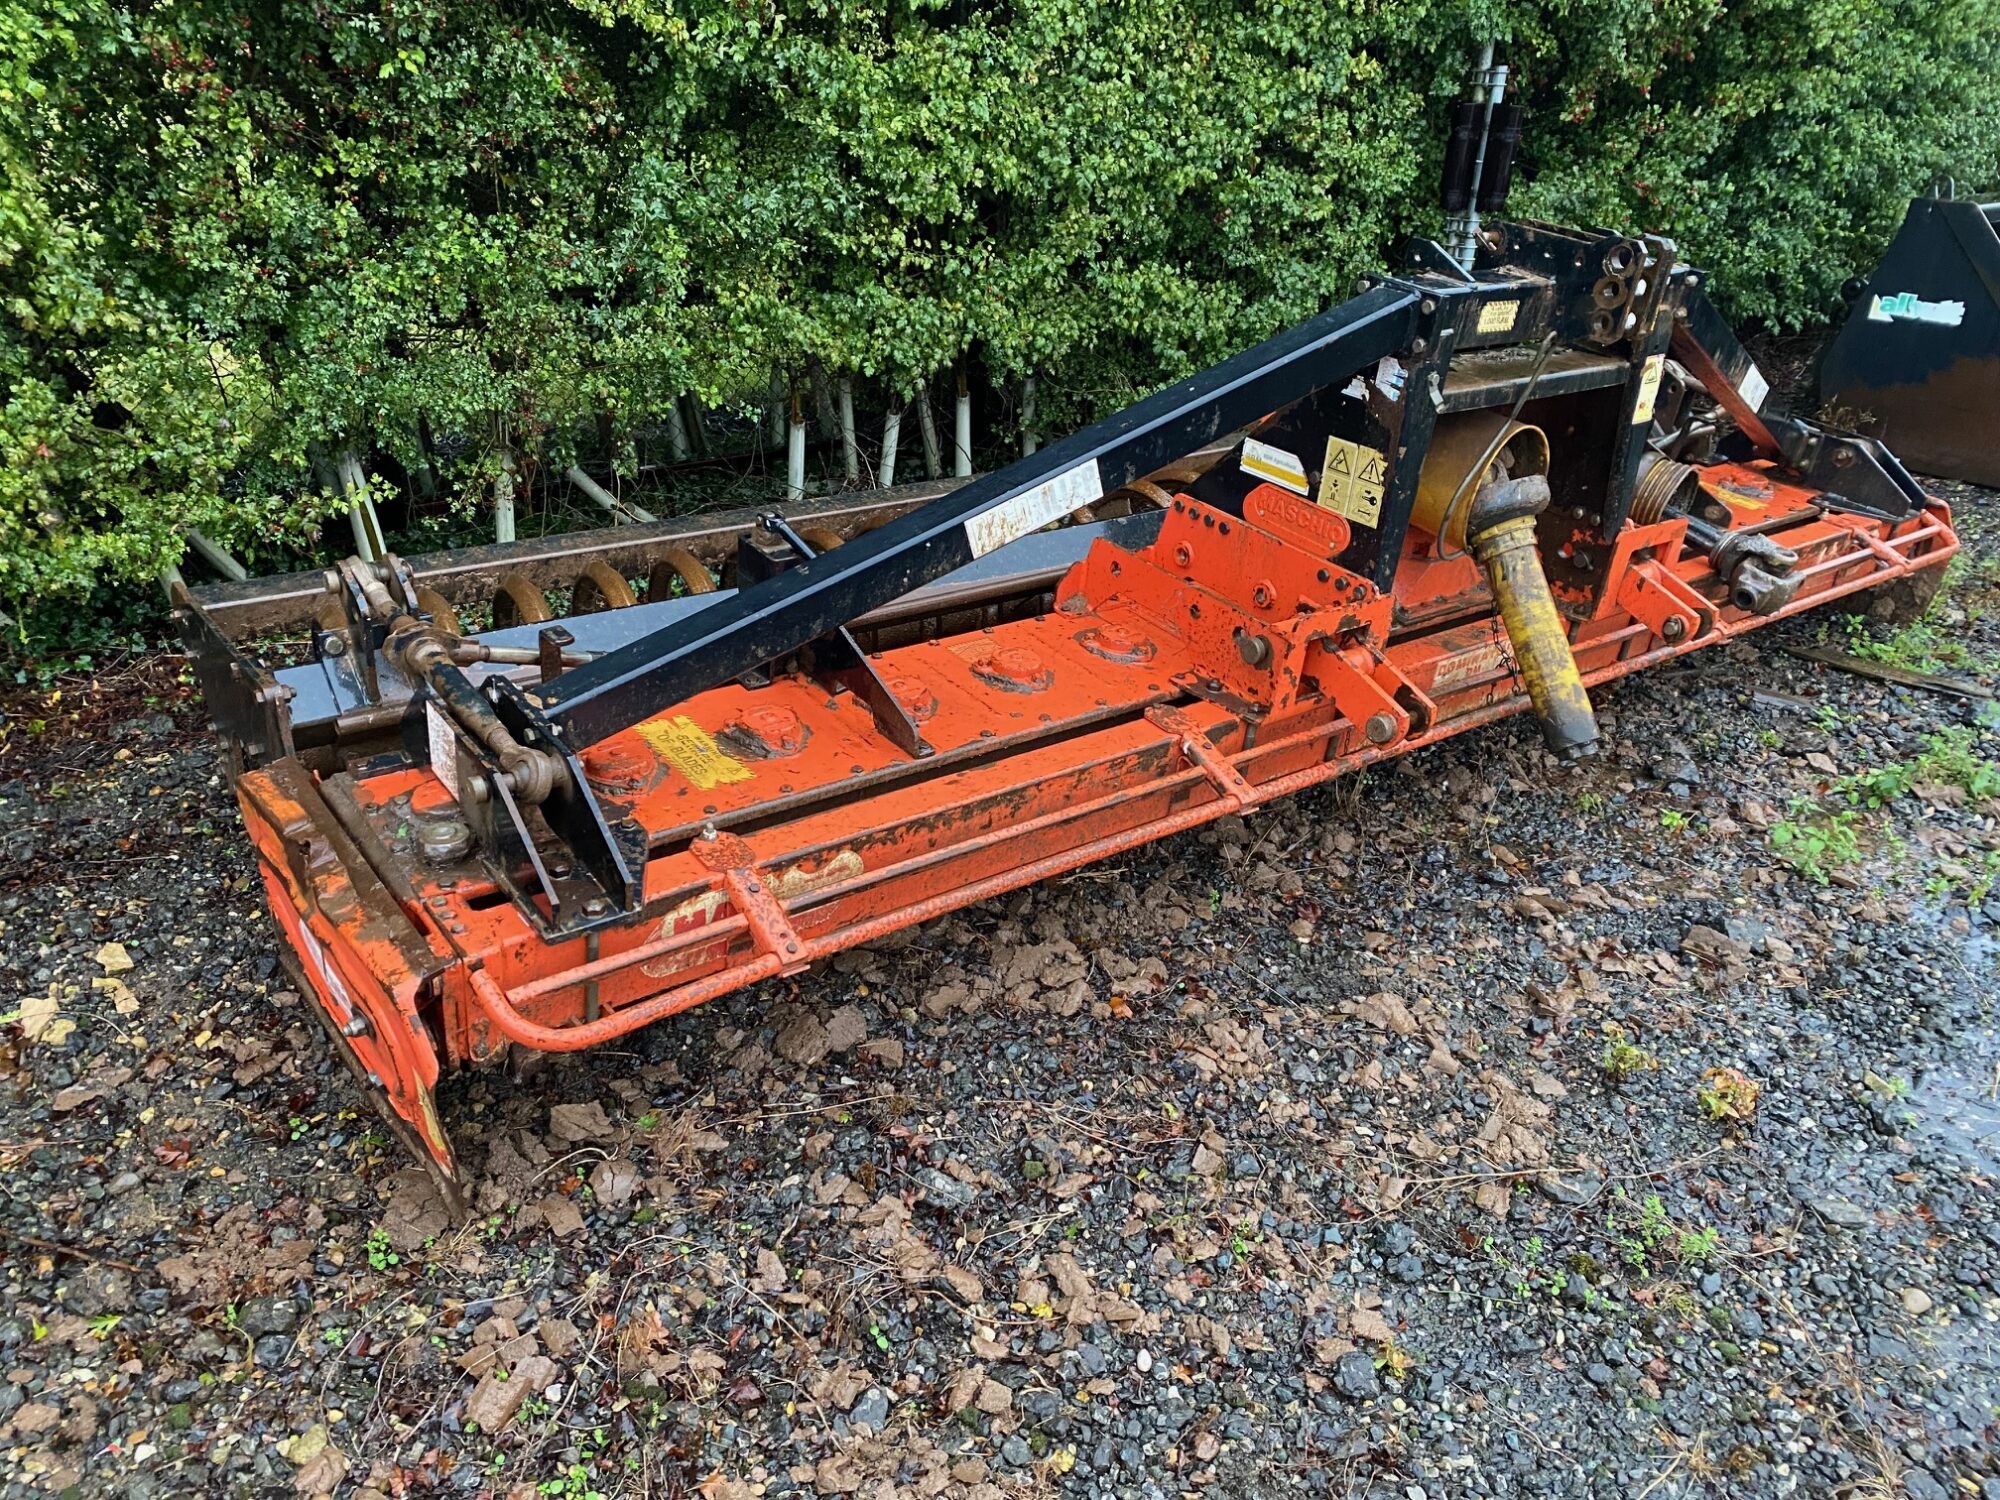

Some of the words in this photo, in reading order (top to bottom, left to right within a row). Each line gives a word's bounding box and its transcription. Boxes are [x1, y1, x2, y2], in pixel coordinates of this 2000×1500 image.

[1256, 490, 1344, 541] MASCHIO
[656, 733, 675, 744] OF
[670, 745, 708, 775] BLADES
